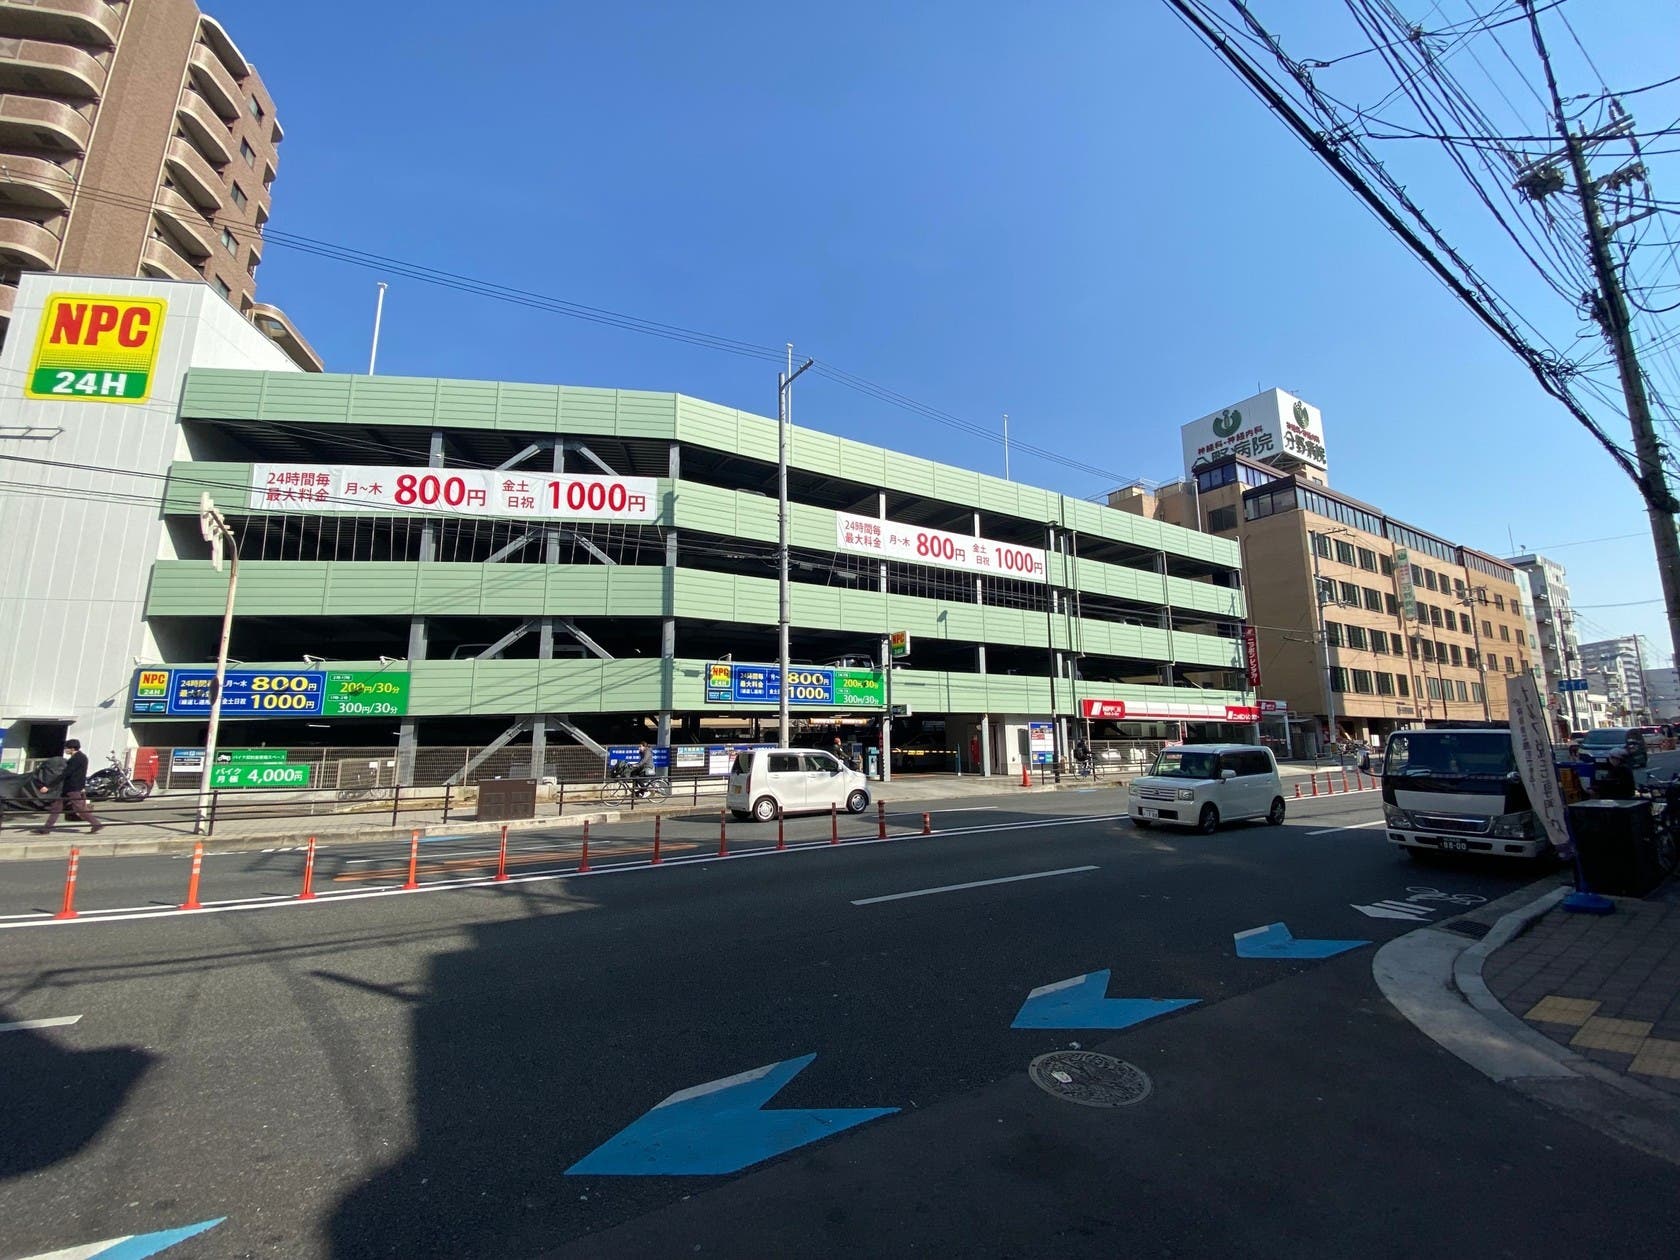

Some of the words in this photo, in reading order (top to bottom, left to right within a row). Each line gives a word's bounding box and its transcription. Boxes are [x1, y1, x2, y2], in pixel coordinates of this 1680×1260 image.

[49, 303, 150, 347] NPC
[52, 372, 127, 396] 24H
[266, 472, 331, 487] 24時間毎
[502, 479, 530, 493] 金土
[265, 486, 330, 502] 最大料金
[394, 474, 486, 506] 800円
[547, 480, 645, 512] 1000円
[507, 495, 535, 510] 日祝
[845, 520, 881, 536] 24時間毎
[845, 532, 882, 549] 最大料金
[916, 532, 966, 562] 800円
[972, 544, 987, 554] 金土
[995, 547, 1043, 575] 1000円
[143, 673, 166, 685] NPC
[251, 676, 317, 692] 800円
[788, 672, 830, 686] 800円
[340, 682, 400, 694] 200円/30分
[788, 686, 830, 700] 1000円
[251, 694, 315, 710] 1000円
[337, 702, 398, 714] 300円/30分
[215, 767, 242, 776] バイク
[247, 768, 303, 784] 4,000円
